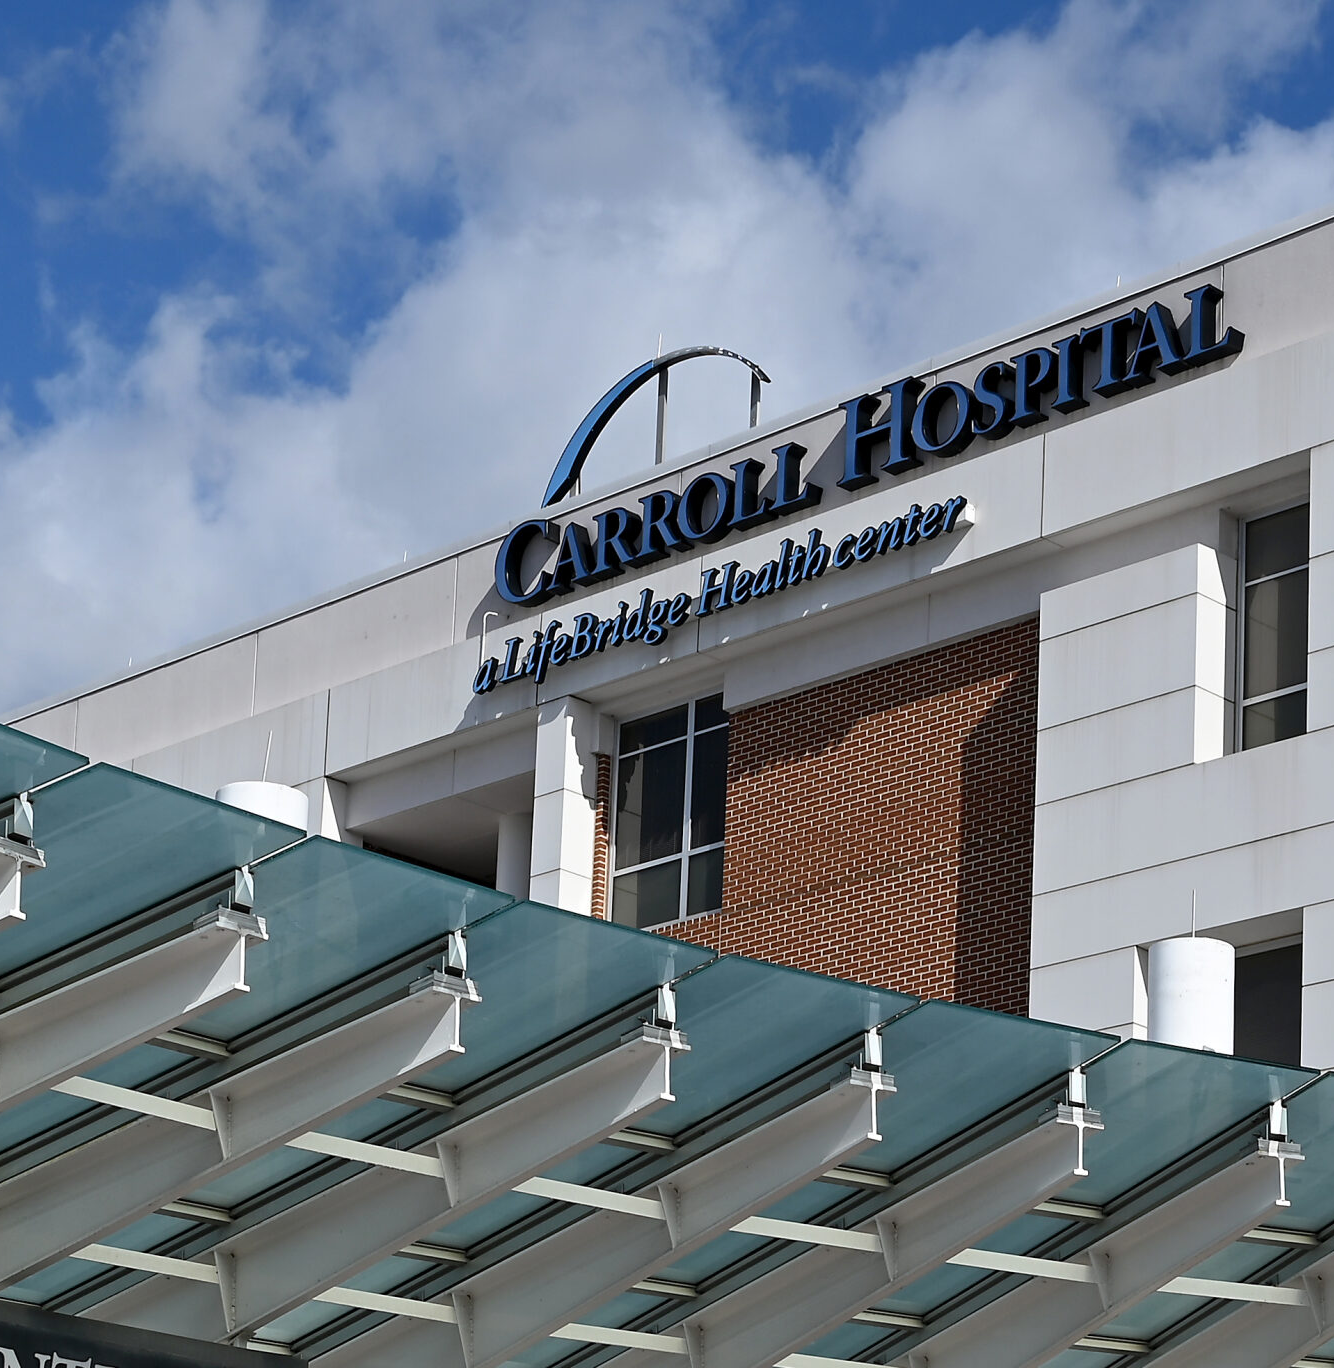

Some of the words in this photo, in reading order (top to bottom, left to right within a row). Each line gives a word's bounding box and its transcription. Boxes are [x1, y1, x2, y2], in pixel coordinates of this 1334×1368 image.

[495, 442, 823, 607] CARROLL
[837, 284, 1246, 492] HOSPITAL
[473, 655, 499, 695] a
[499, 588, 691, 684] LifeBridge
[696, 528, 832, 618] Health
[832, 495, 967, 571] center
